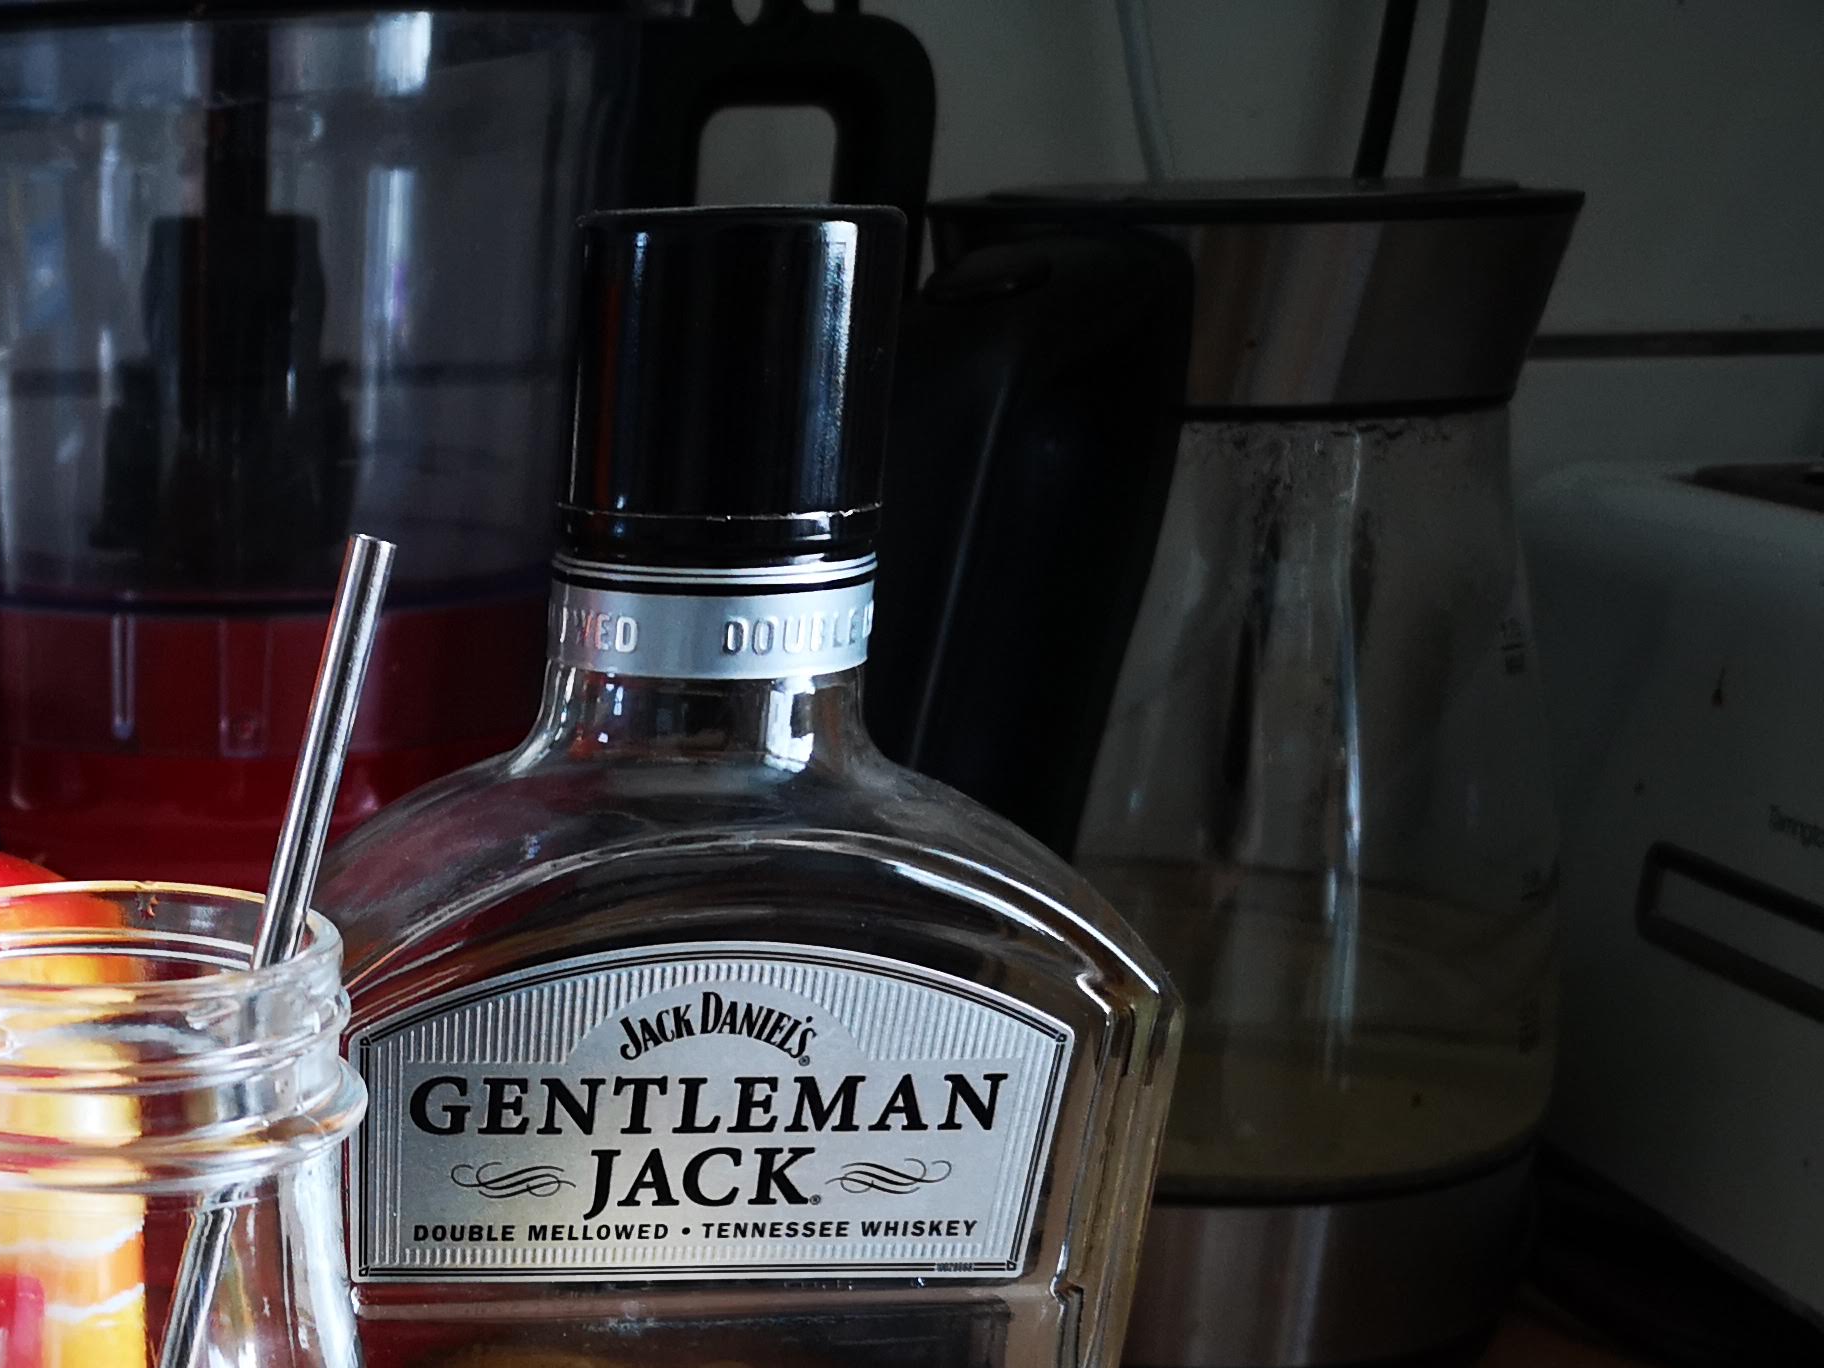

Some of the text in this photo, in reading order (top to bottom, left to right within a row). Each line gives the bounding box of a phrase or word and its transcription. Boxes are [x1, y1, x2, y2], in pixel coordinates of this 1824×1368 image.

[619, 991, 818, 1061] JACK DANIEL'S
[409, 1073, 1008, 1136] GENTLEMAN
[583, 1147, 816, 1221] JACK
[413, 1220, 978, 1242] DOUBLE MELLOWED TENNESSEE WHISKEY
